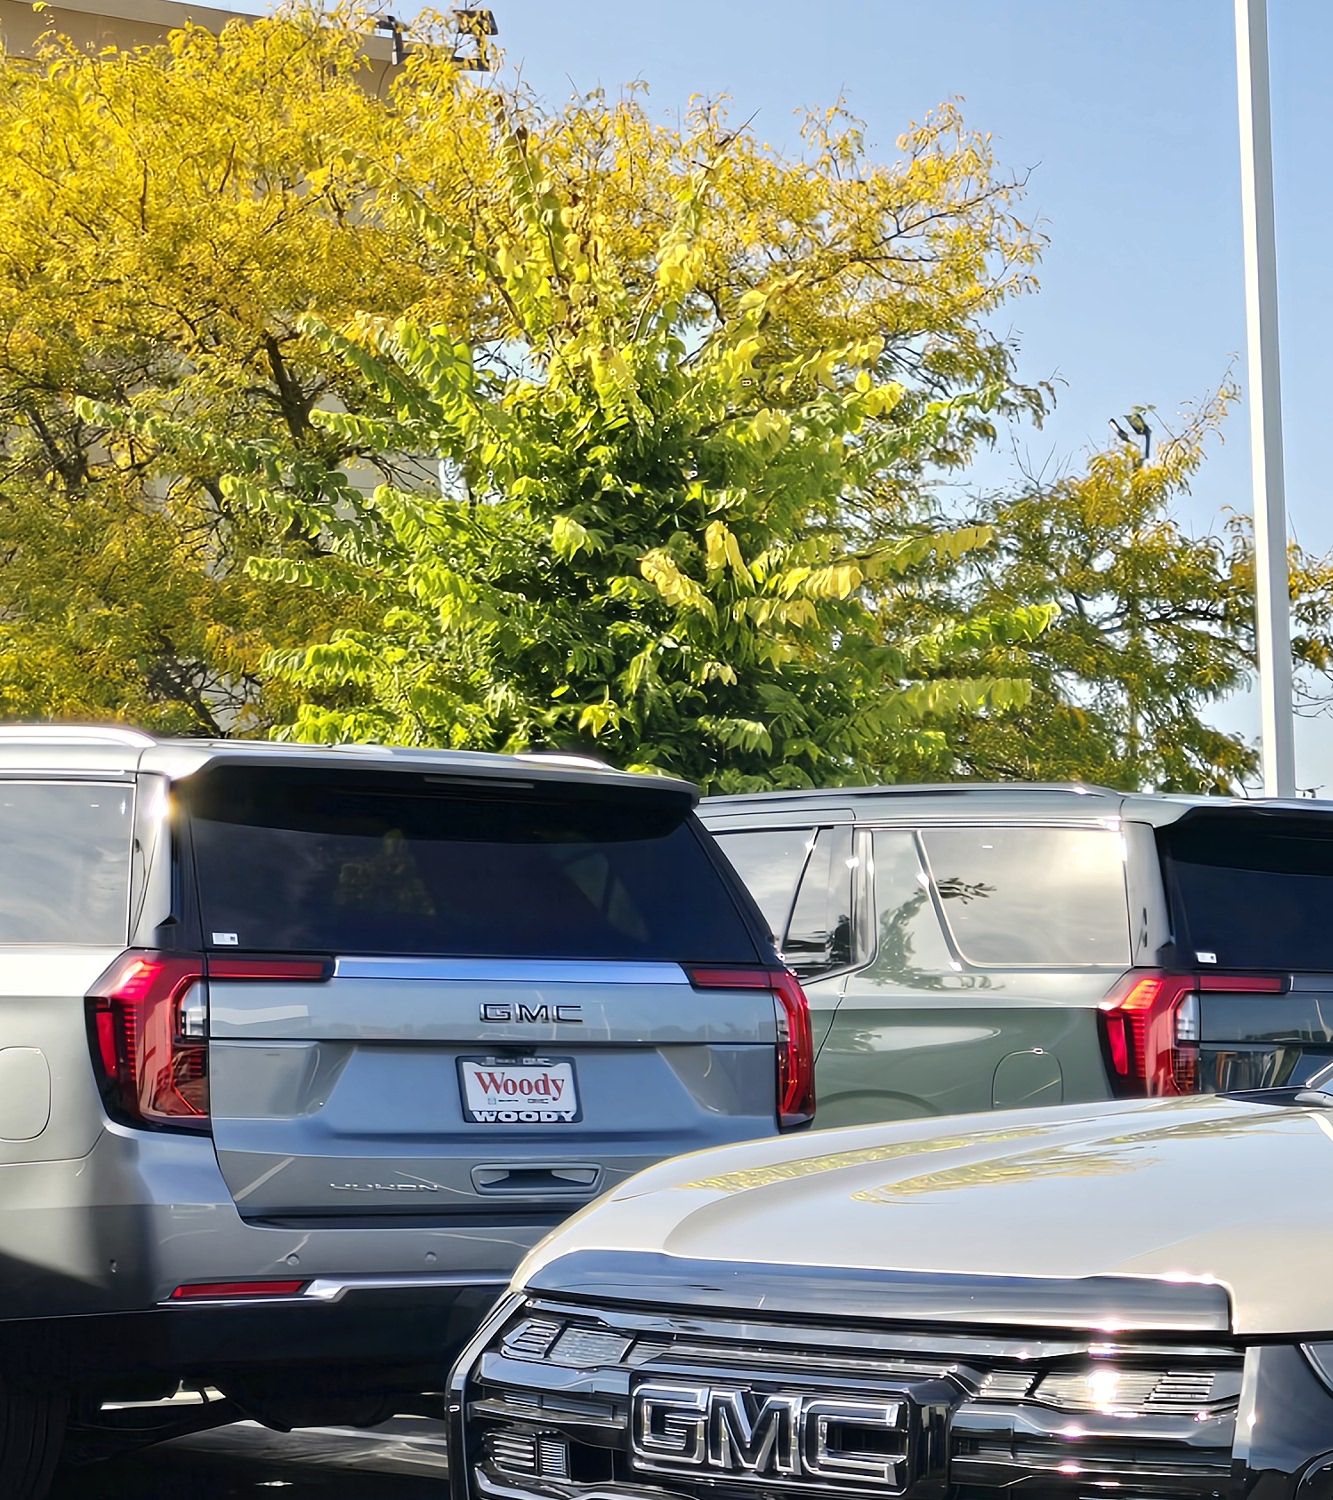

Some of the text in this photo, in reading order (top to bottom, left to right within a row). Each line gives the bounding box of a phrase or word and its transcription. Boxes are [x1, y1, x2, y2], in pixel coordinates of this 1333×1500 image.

[479, 1003, 584, 1024] GMC
[474, 1071, 565, 1101] Woody
[472, 1110, 576, 1122] WOODY
[632, 1381, 908, 1487] GMC
